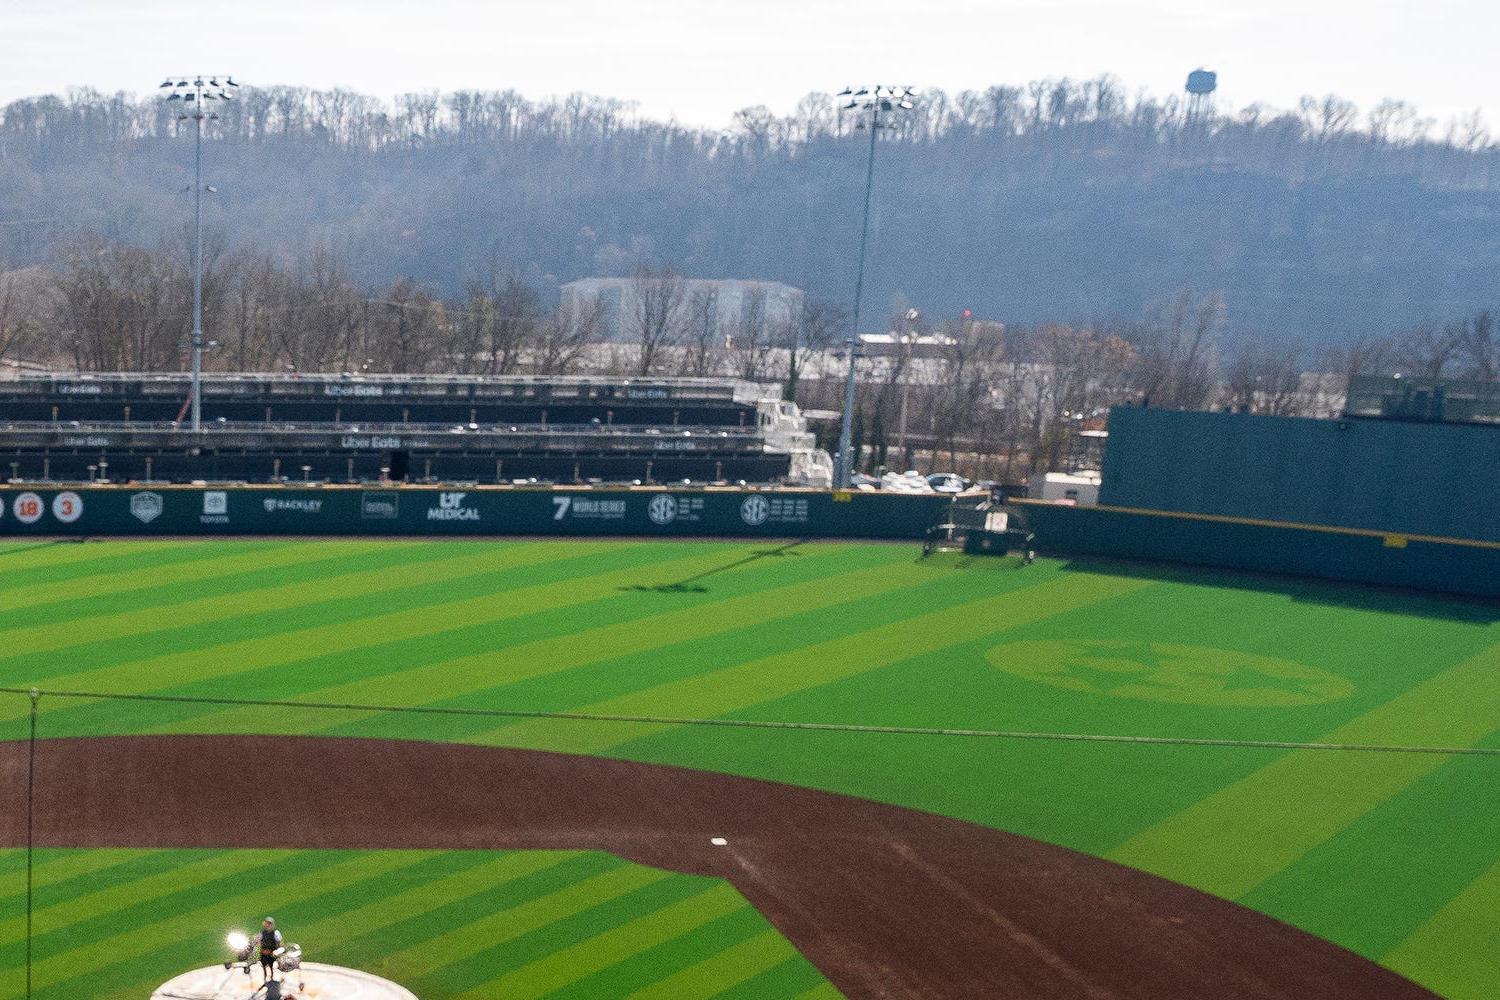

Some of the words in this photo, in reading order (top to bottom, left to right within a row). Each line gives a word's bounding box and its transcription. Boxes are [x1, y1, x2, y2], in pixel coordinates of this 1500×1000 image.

[19, 501, 38, 516] 18
[62, 500, 73, 515] 3
[277, 500, 322, 510] RACKLEY
[552, 497, 571, 520] 7
[572, 500, 598, 513] WORLD
[599, 500, 626, 513] SERIES
[427, 507, 480, 520] MEDICAL
